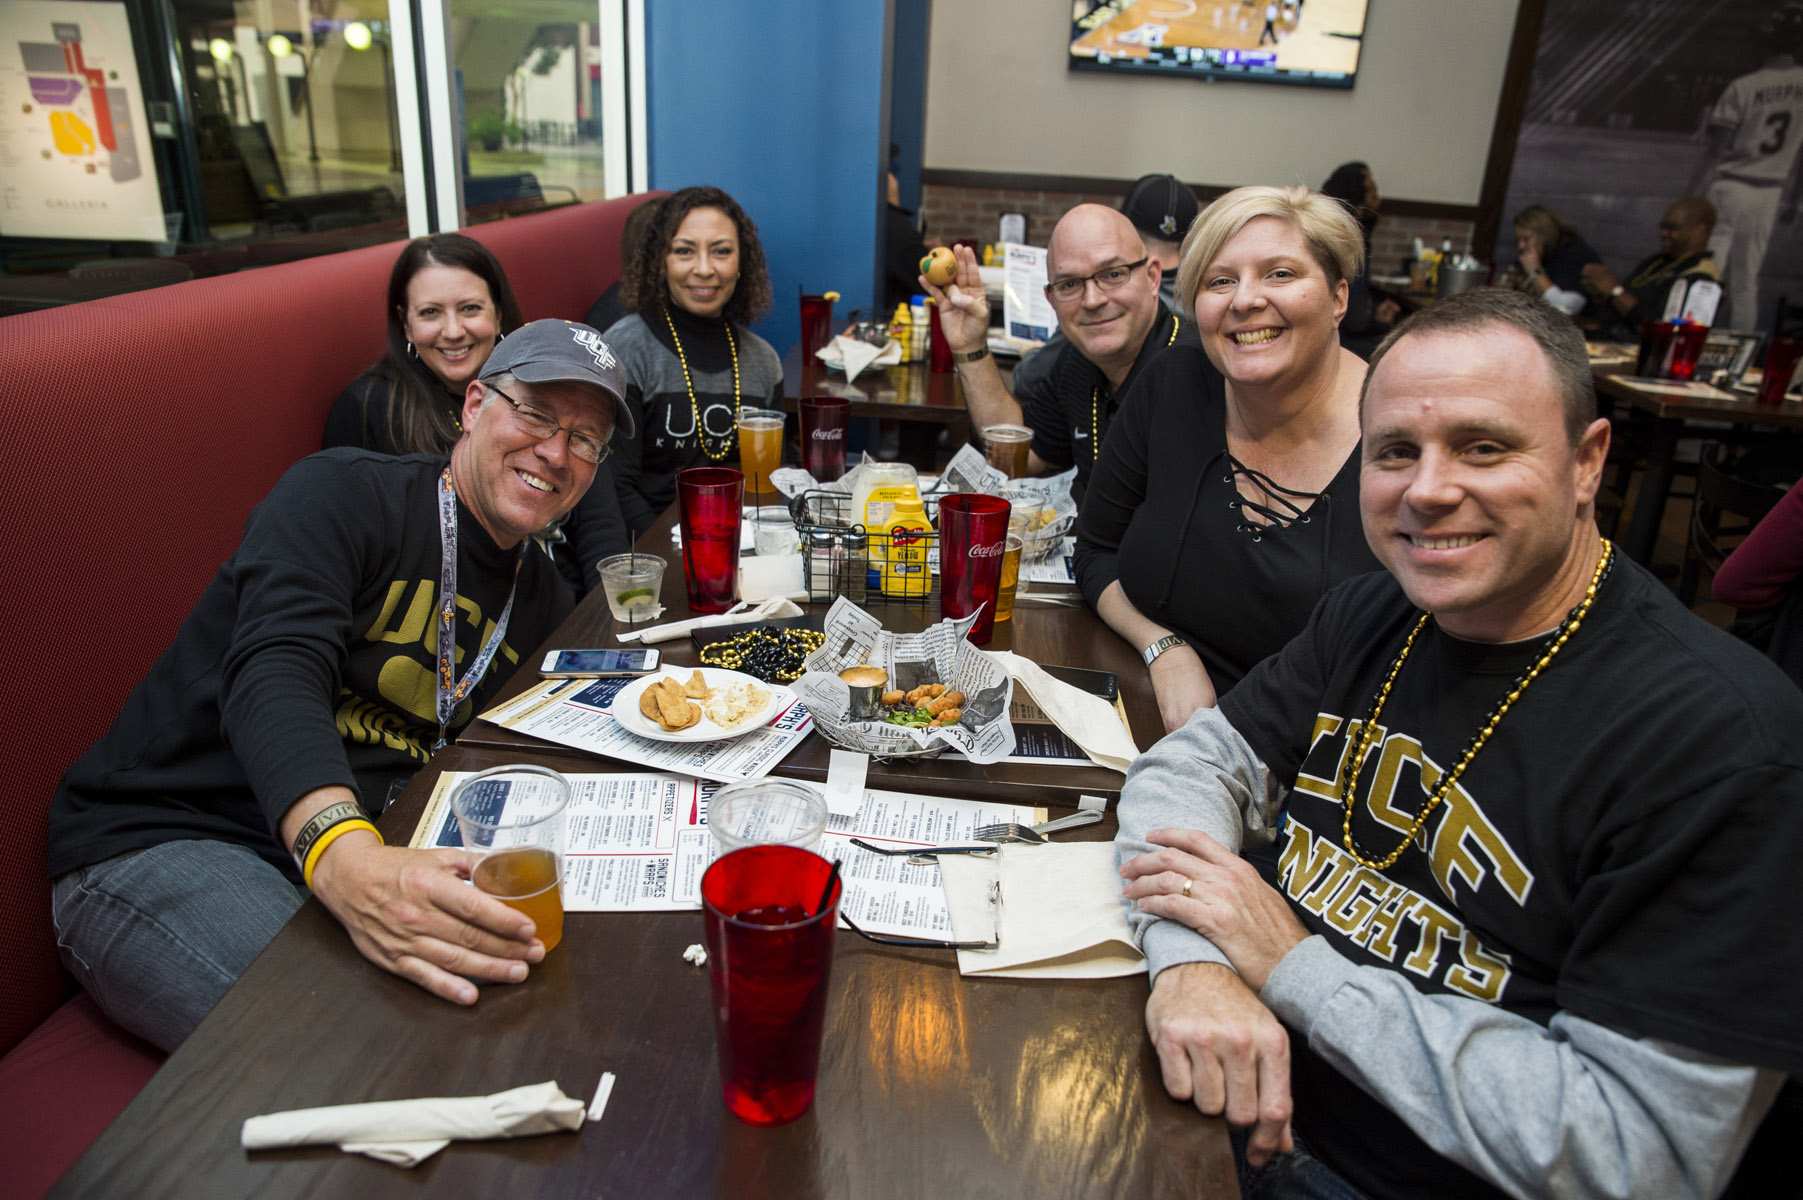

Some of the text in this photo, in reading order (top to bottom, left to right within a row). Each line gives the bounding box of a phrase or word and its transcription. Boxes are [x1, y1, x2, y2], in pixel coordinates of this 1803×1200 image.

[1759, 109, 1792, 155] 3
[655, 437, 732, 449] KNIGH
[323, 804, 352, 821] VIP
[664, 783, 676, 814] APPETIZERS
[1294, 712, 1535, 907] UCF
[297, 824, 318, 849] VIP
[643, 864, 655, 885] WRAPS
[654, 858, 669, 897] SANDWICHES
[1278, 814, 1512, 1003] NIGHTS
